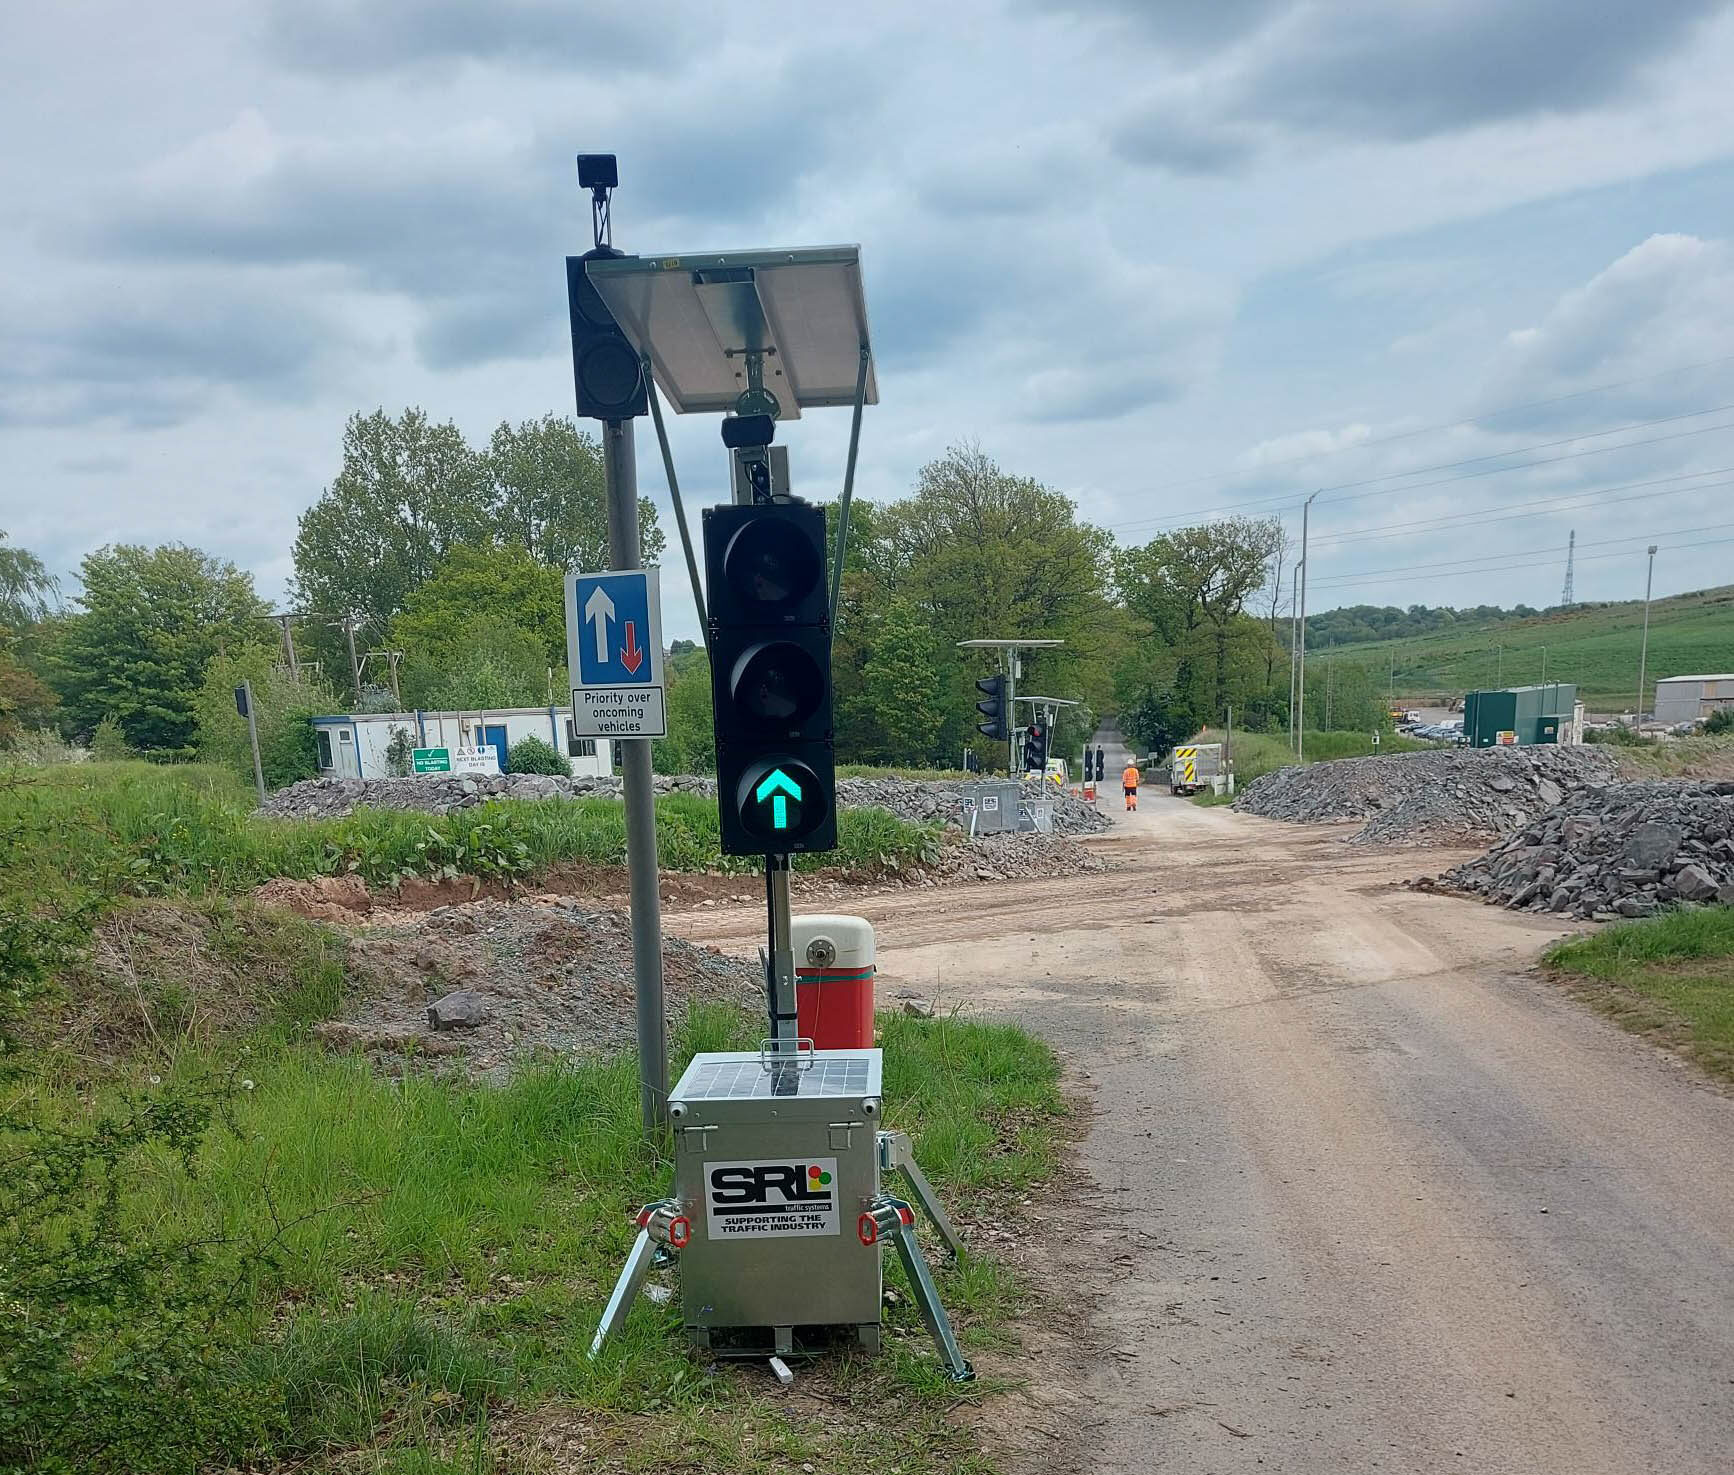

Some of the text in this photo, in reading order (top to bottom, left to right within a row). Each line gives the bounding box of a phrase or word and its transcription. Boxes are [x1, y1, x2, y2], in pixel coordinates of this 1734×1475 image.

[584, 692, 651, 705] Priority over
[592, 706, 644, 719] oncoming
[598, 720, 641, 732] vehicles
[711, 1165, 831, 1203] SRL
[804, 1204, 830, 1212] systems
[725, 1214, 822, 1225] SUPPORTING THE
[720, 1221, 826, 1233] TRAFFIC INDUSTRY
